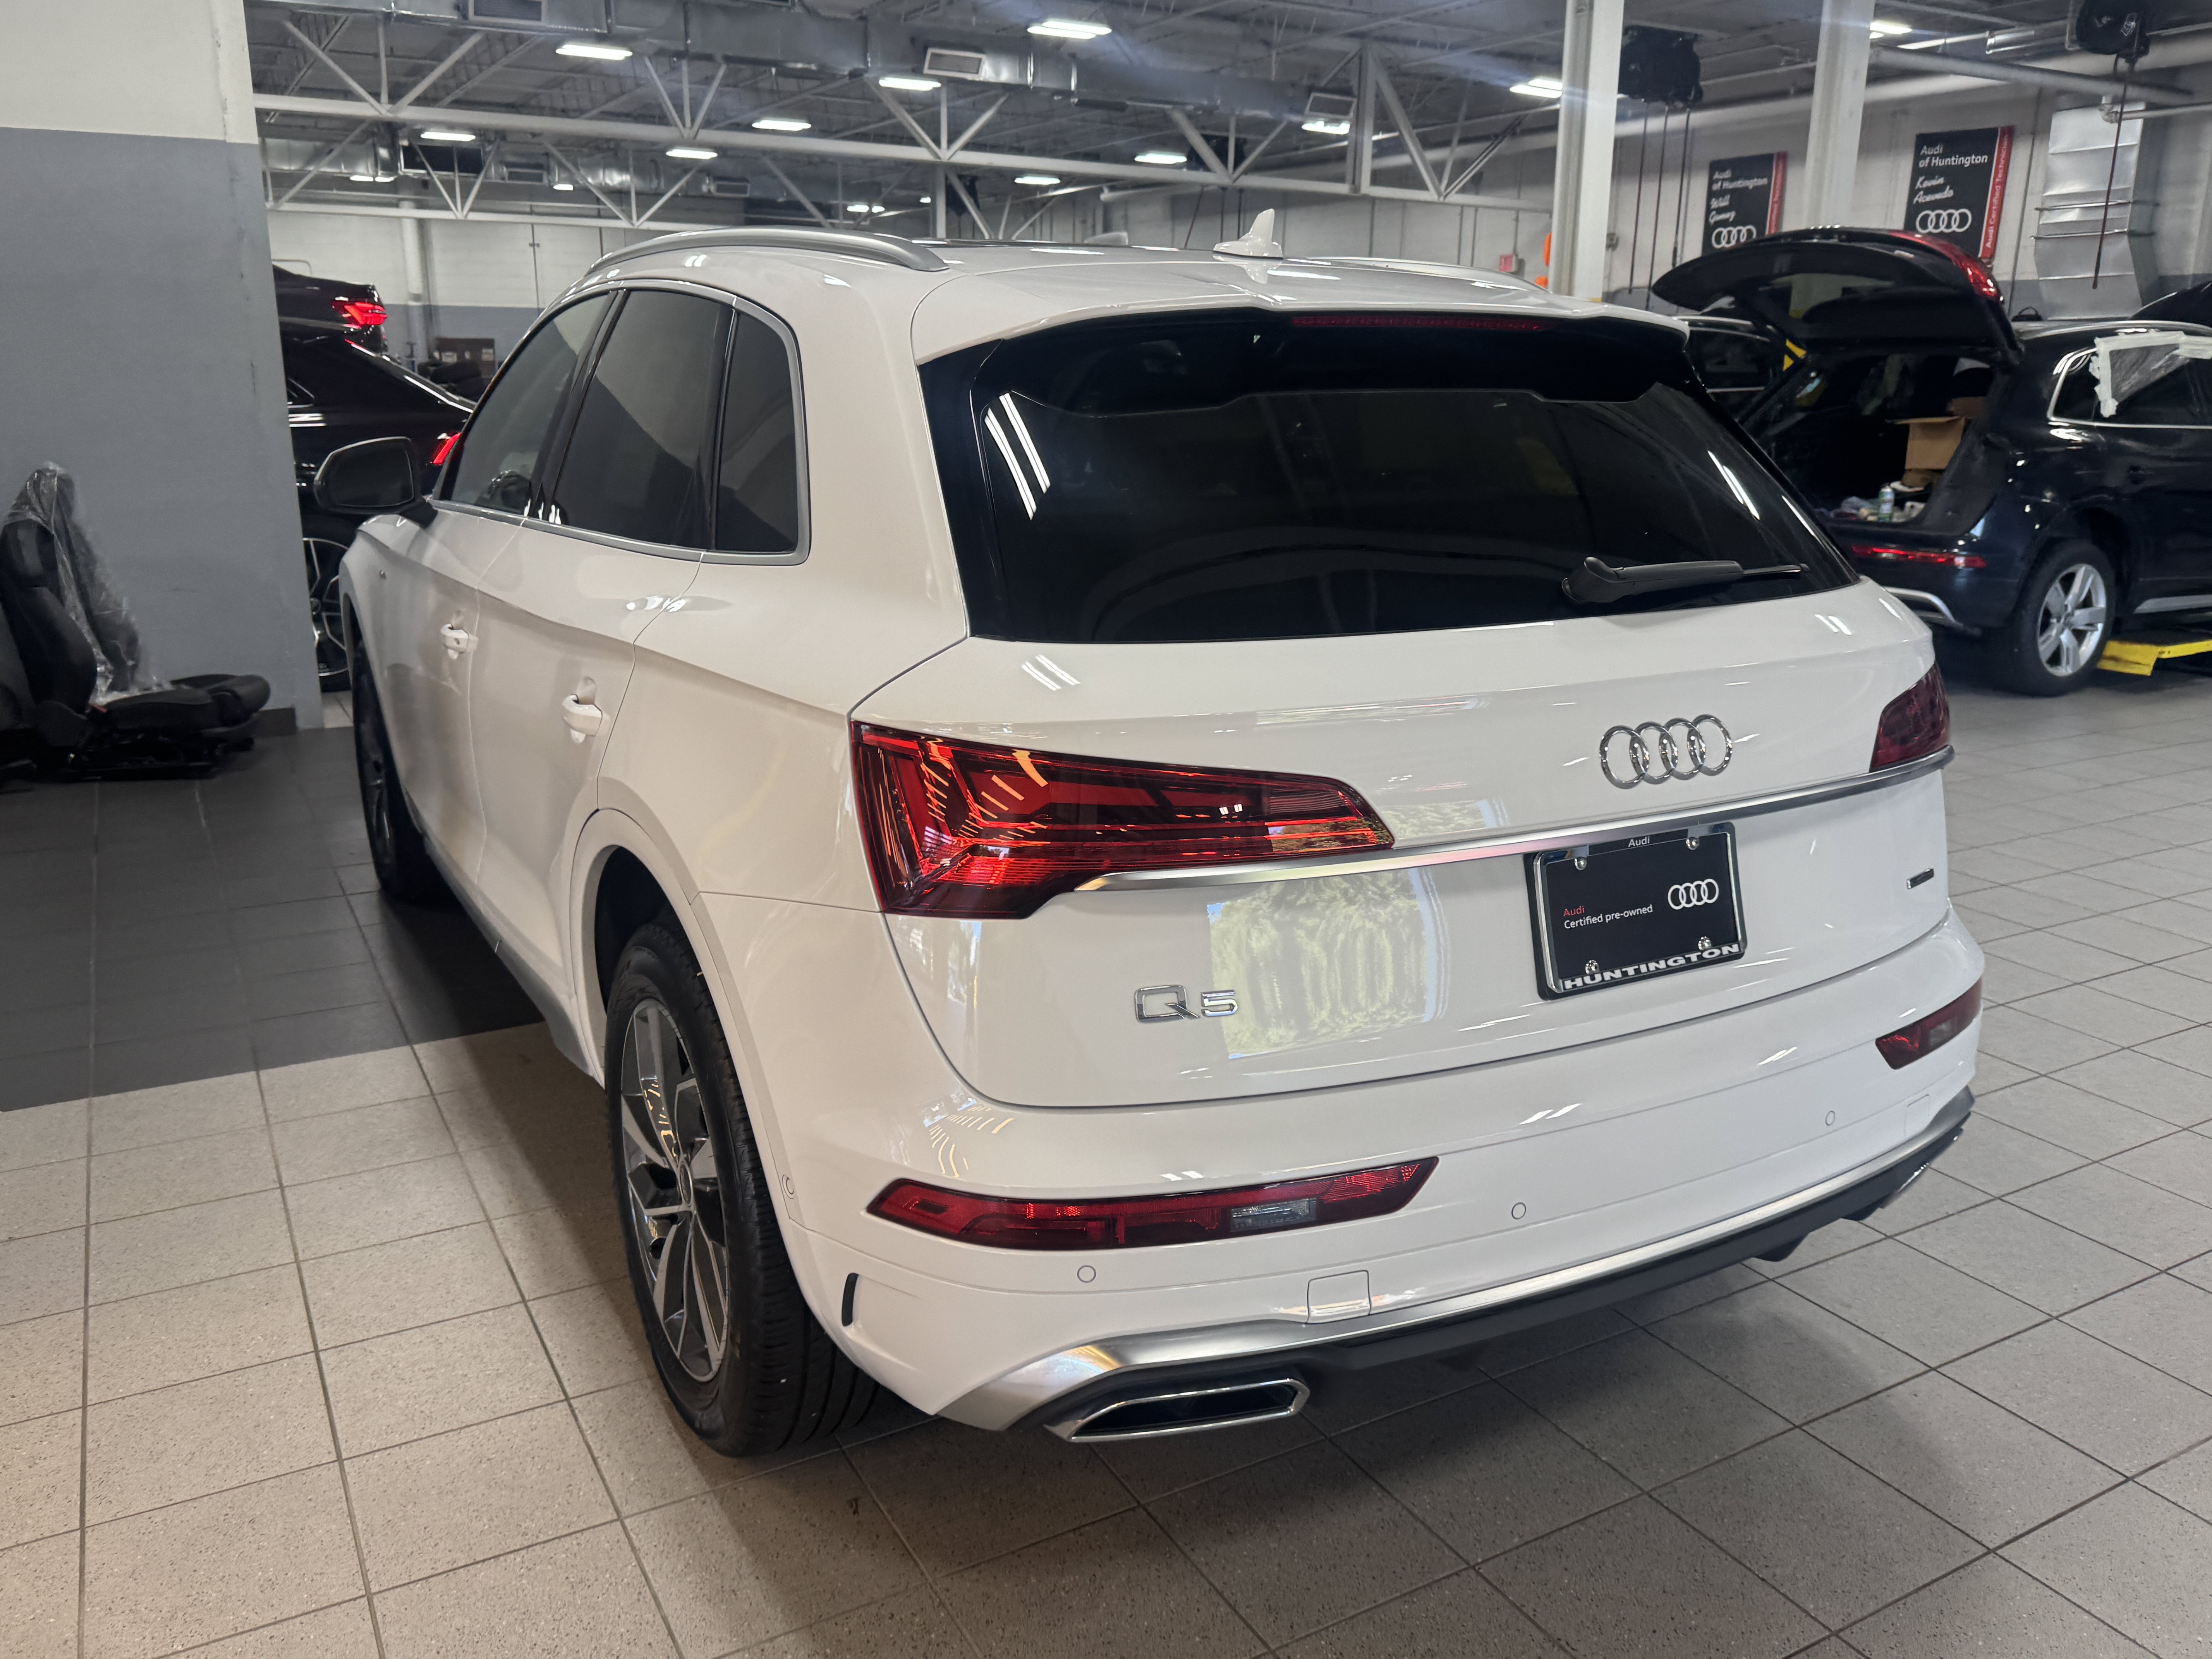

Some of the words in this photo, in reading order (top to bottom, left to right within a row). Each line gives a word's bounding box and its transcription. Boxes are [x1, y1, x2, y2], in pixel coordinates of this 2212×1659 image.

[1920, 144, 1943, 155] Audi
[1919, 157, 1930, 168] of
[1931, 155, 1988, 167] Huntington
[1986, 226, 1994, 248] Audi
[1628, 836, 1650, 847] Audi
[1563, 905, 1585, 917] Audi
[1564, 913, 1603, 929] Certified
[1606, 904, 1653, 922] pre-owned
[1565, 944, 1739, 989] HUNTINGTON
[1134, 984, 1238, 1024] Q5
